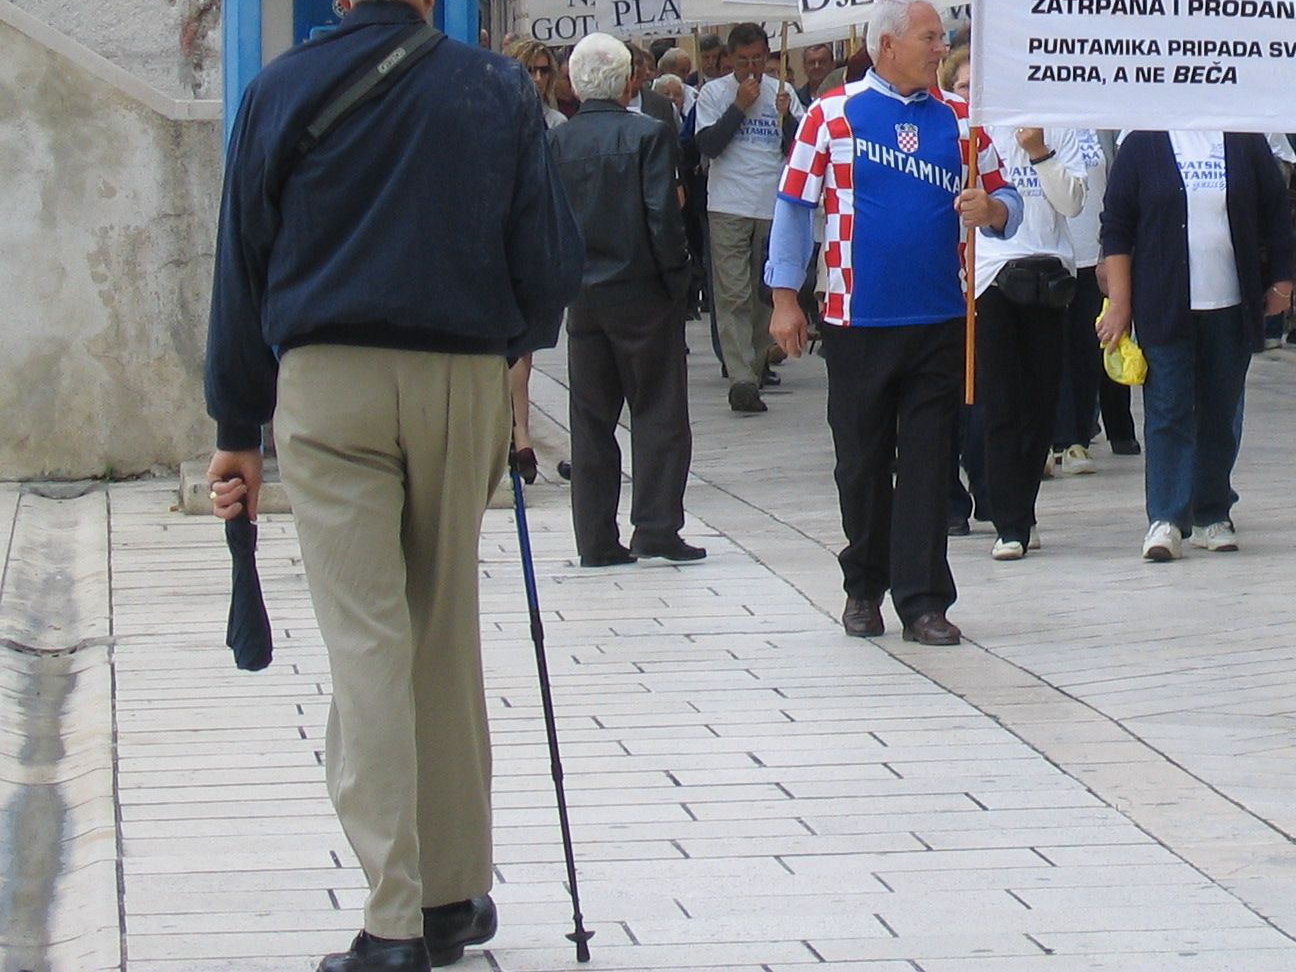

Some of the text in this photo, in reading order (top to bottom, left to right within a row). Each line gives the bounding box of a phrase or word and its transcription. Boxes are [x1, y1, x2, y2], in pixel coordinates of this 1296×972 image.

[1028, 38, 1161, 56] PUNTAMIKA
[1168, 40, 1263, 59] PRIPADA
[1028, 61, 1238, 85] ZADRA, A NE BEČA
[856, 138, 962, 195] PUNTAMIKA
